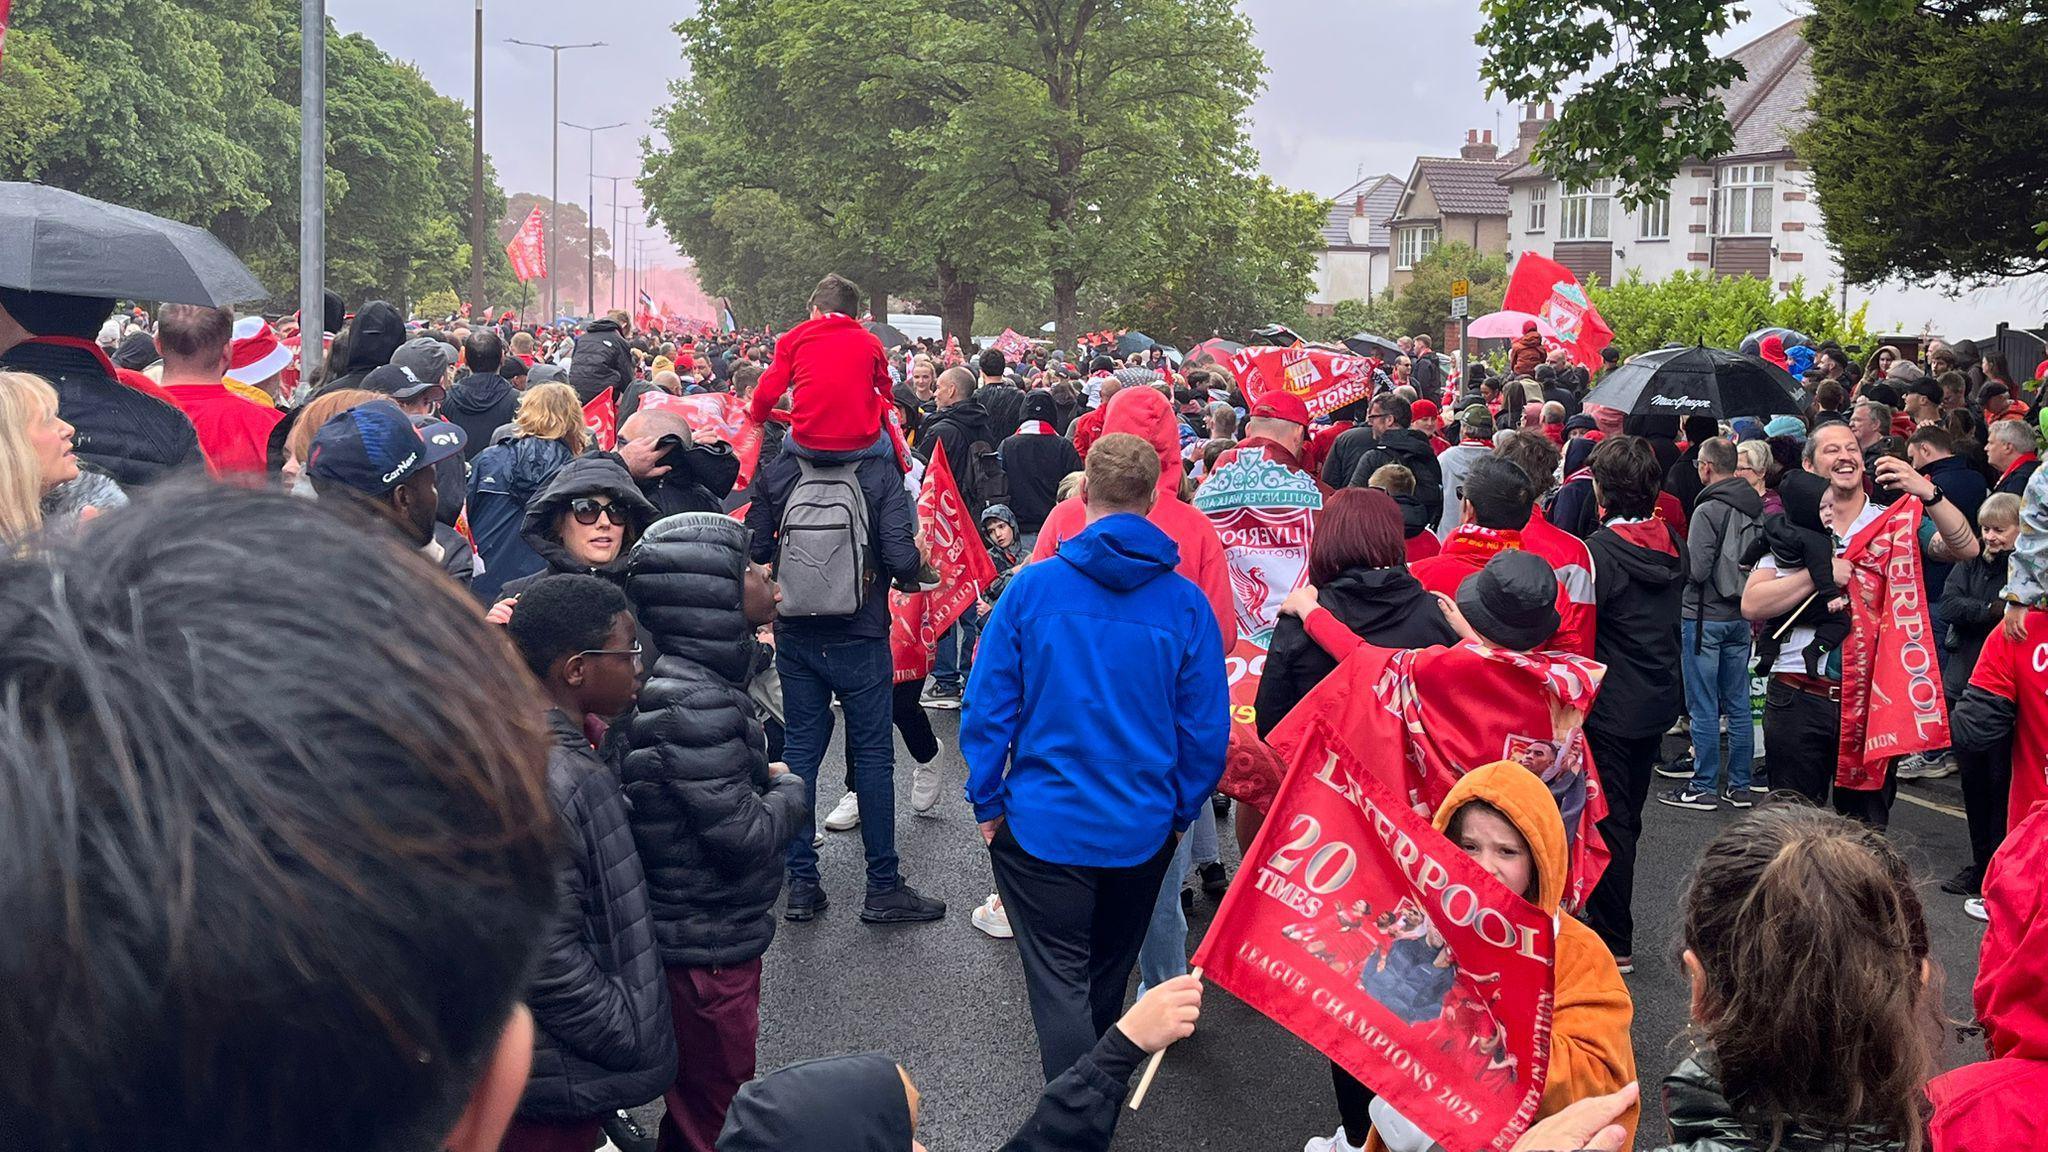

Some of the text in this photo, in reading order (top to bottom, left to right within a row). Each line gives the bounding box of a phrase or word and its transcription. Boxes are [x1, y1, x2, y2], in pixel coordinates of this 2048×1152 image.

[1282, 350, 1310, 368] ALLEZ
[1283, 373, 1313, 391] ALLEZ
[1304, 379, 1366, 412] PIONS
[1651, 394, 1711, 410] MacGregor
[382, 452, 417, 483] CarNext
[1888, 508, 1942, 740] IVERPOOL
[1864, 731, 1899, 752] TION
[1267, 813, 1357, 895] 20
[1254, 866, 1324, 919] TIMES
[1237, 941, 1484, 1125] LEAGUE CHAMPIONS 2025
[1492, 987, 1554, 1152] POETRY IN MOTION
